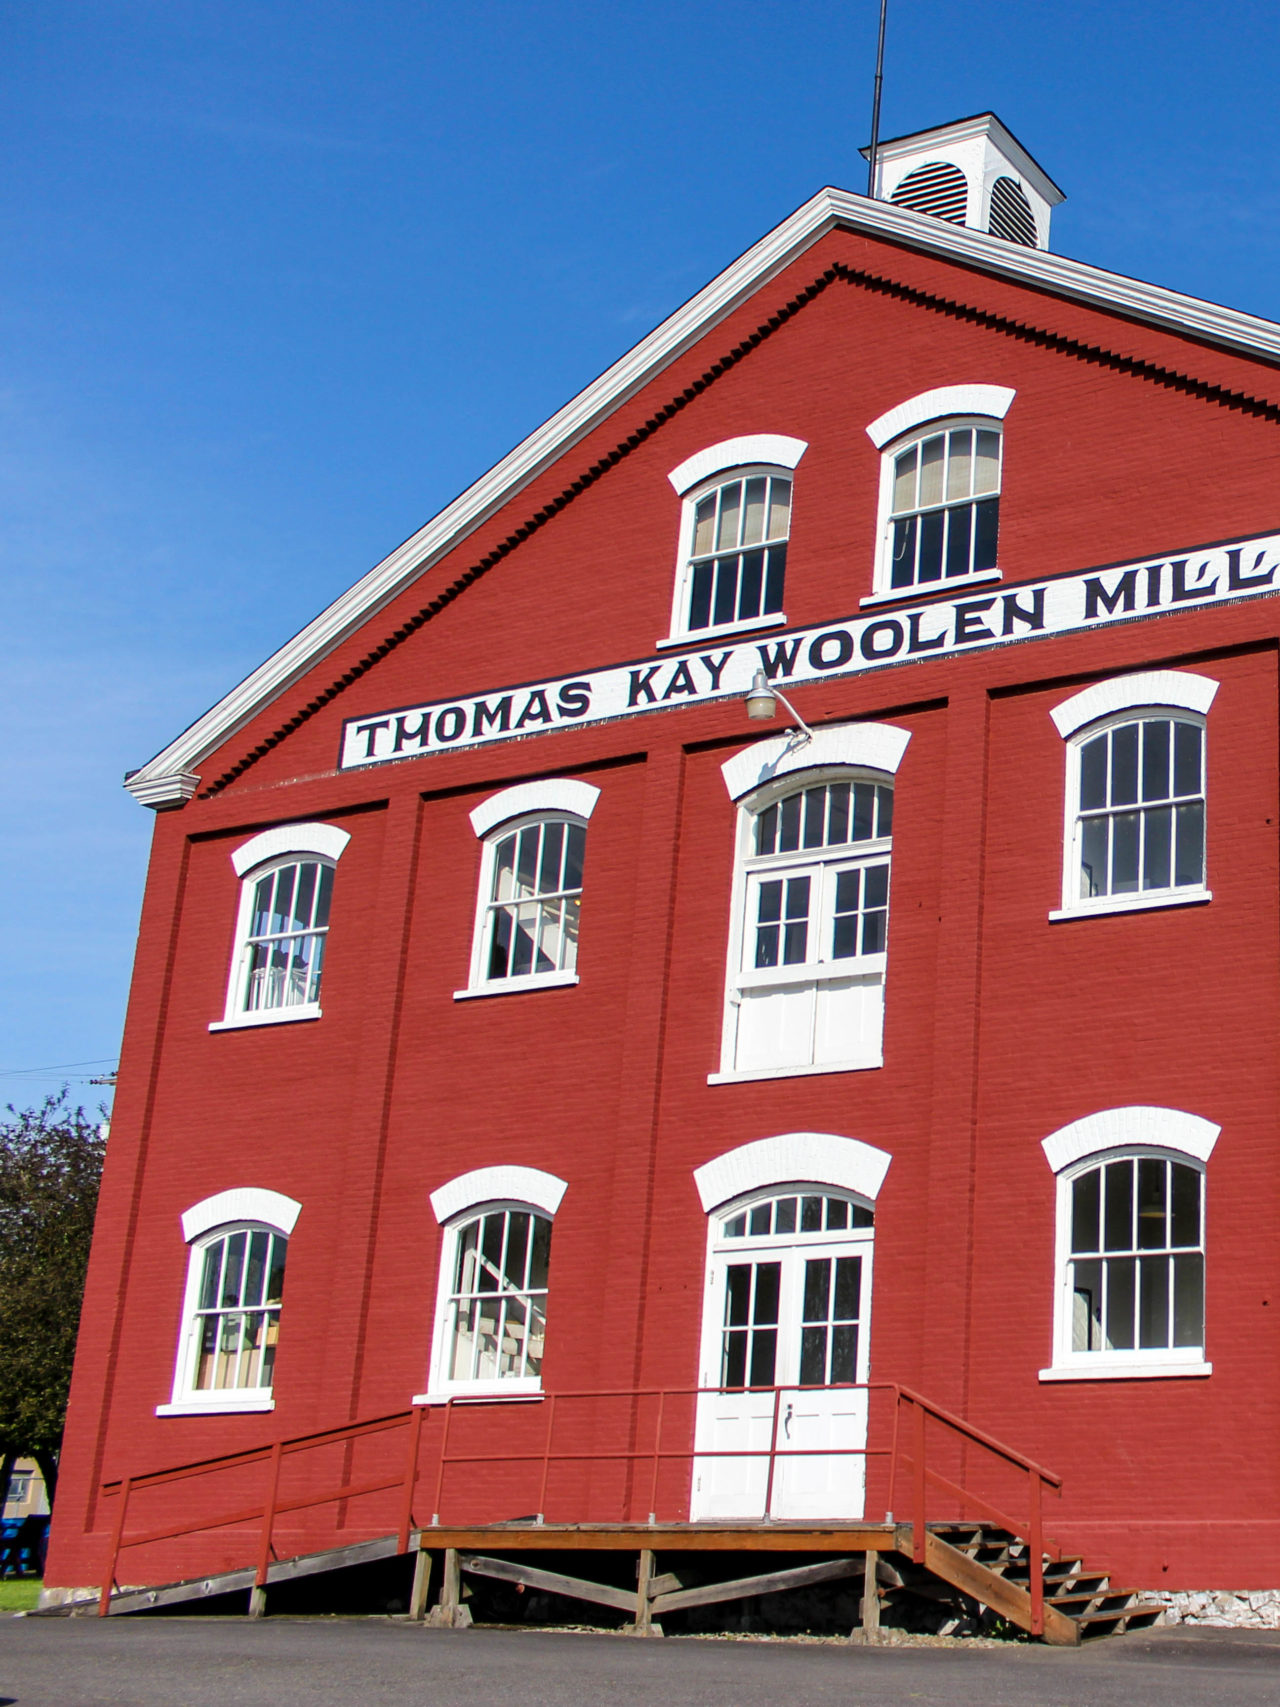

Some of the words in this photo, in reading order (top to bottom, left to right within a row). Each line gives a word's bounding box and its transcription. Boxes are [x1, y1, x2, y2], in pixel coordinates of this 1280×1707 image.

[356, 681, 593, 759] THOMAS
[627, 650, 735, 708] KAY
[755, 586, 1049, 679] WOOLEN
[1082, 547, 1280, 620] MILL
